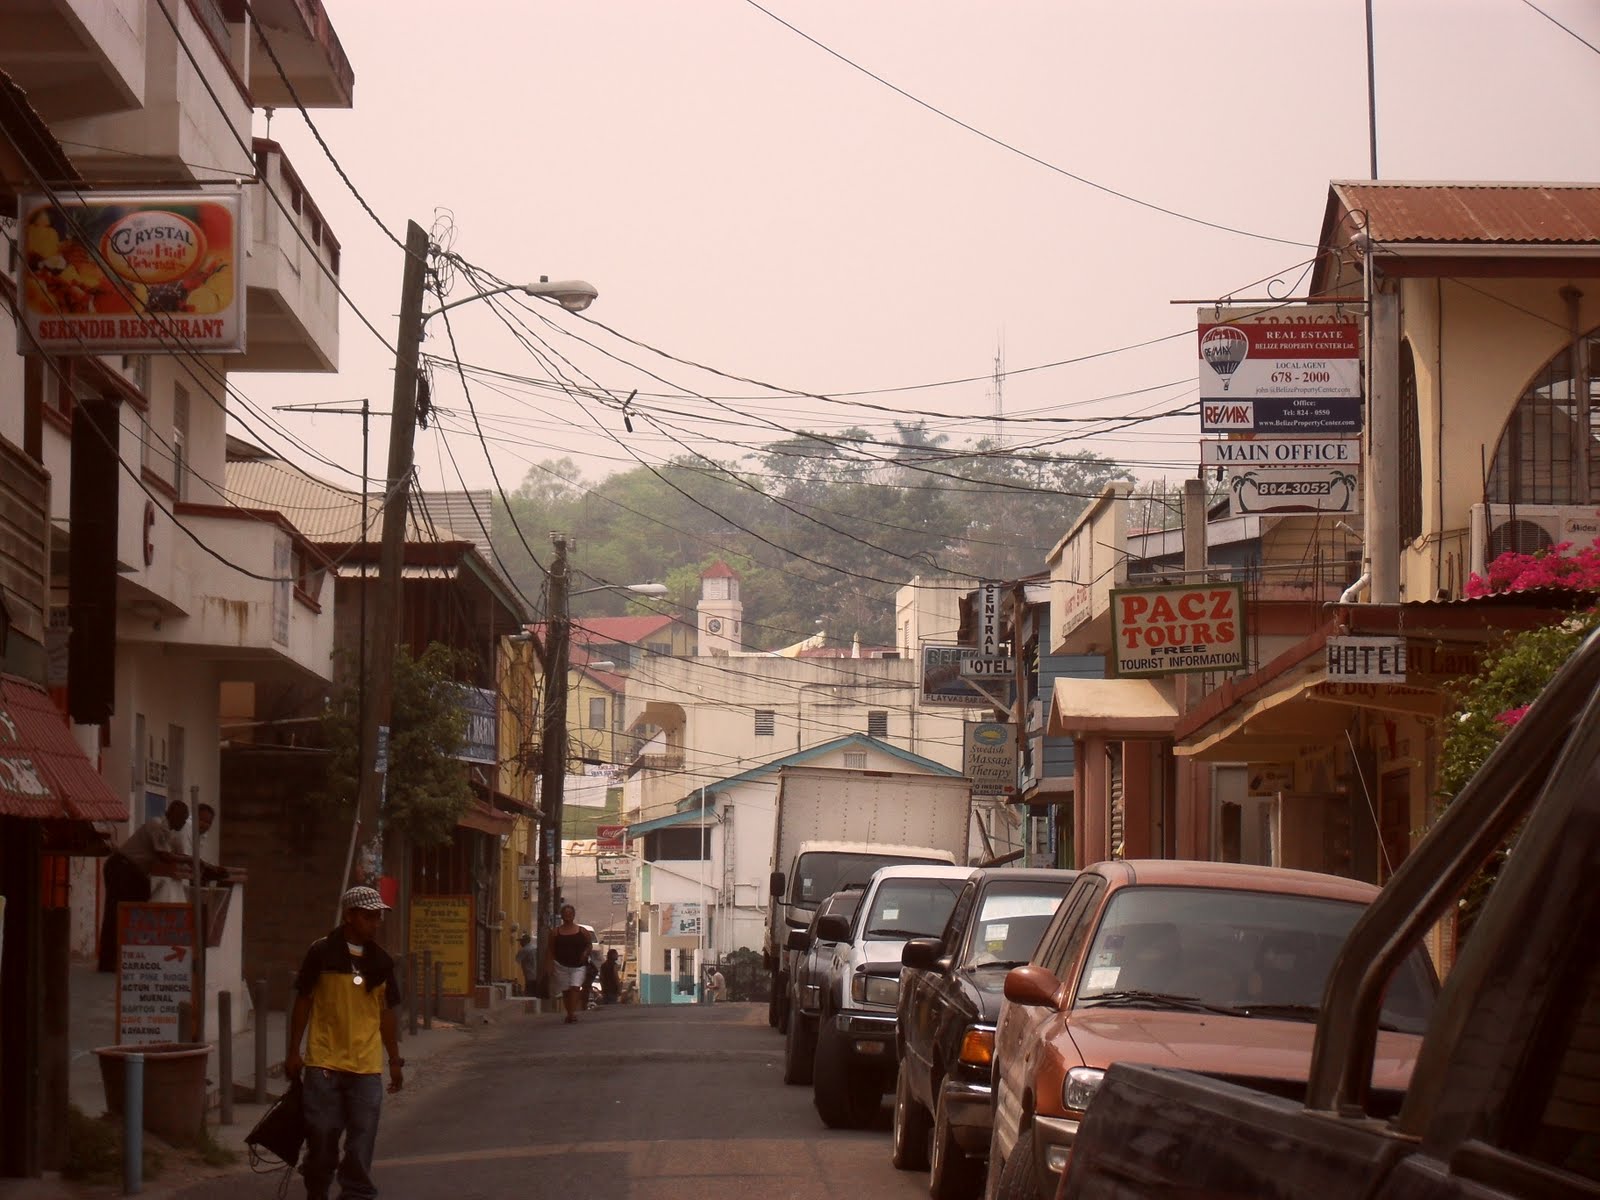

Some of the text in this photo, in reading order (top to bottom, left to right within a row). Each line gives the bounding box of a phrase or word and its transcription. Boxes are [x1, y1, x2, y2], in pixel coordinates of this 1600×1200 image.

[39, 319, 224, 339] SERENDIB RESTAURANT
[1266, 331, 1343, 339] REAL ESTATE
[1271, 371, 1292, 383] 678
[1303, 371, 1330, 383] 2000
[1205, 405, 1250, 424] RE/MAX
[1216, 444, 1348, 461] MAIN OFFICE
[1120, 590, 1233, 625] PACZ
[985, 584, 995, 655] CENTRAL
[1121, 621, 1235, 649] TOURS
[1150, 644, 1207, 656] FREE
[1120, 652, 1240, 670] TOURIST INFORMATION
[1329, 645, 1406, 675] HOTEL
[970, 744, 1005, 755] Swedish
[968, 754, 1013, 767] Massage
[969, 765, 1012, 779] Therapy
[122, 962, 162, 970] CARACOL
